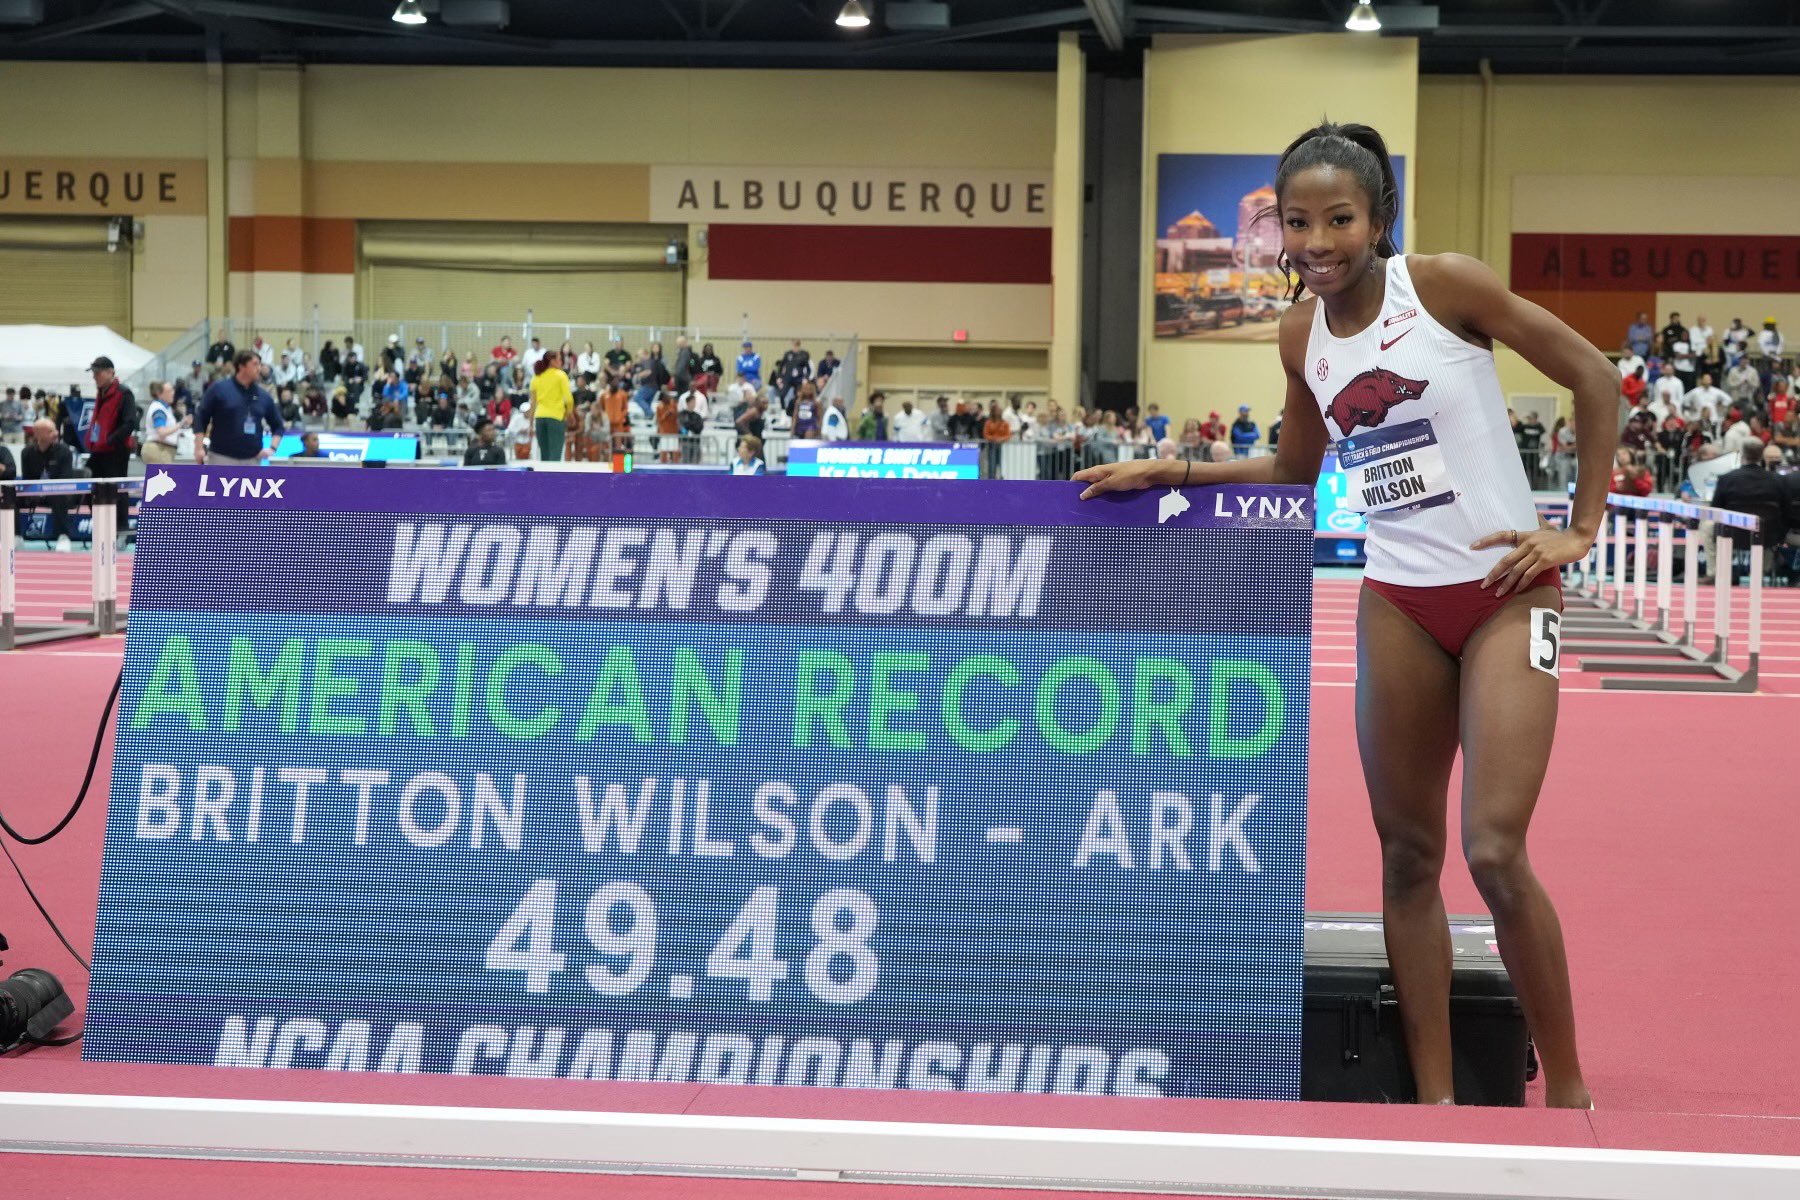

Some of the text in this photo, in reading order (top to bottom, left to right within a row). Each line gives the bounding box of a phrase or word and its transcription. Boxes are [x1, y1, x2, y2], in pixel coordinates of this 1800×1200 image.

[677, 180, 1045, 218] ALBUQUERQUE
[1541, 245, 1800, 284] ALBUQUE
[1382, 433, 1430, 453] CHAMPIONSHIPS
[198, 474, 286, 500] LYNX
[1364, 456, 1415, 484] BRITTON
[1214, 493, 1307, 520] LYNX
[1362, 475, 1426, 507] WILSON
[386, 522, 1052, 618] WOMEN'S 400M
[1539, 611, 1559, 670] 5
[129, 633, 1286, 760] AMERICAN RECORD
[134, 763, 529, 852] BRITTON
[574, 774, 939, 865] WILSON
[1073, 788, 1263, 873] ARK
[485, 878, 880, 1005] 49.48
[214, 1014, 425, 1075] NCAA
